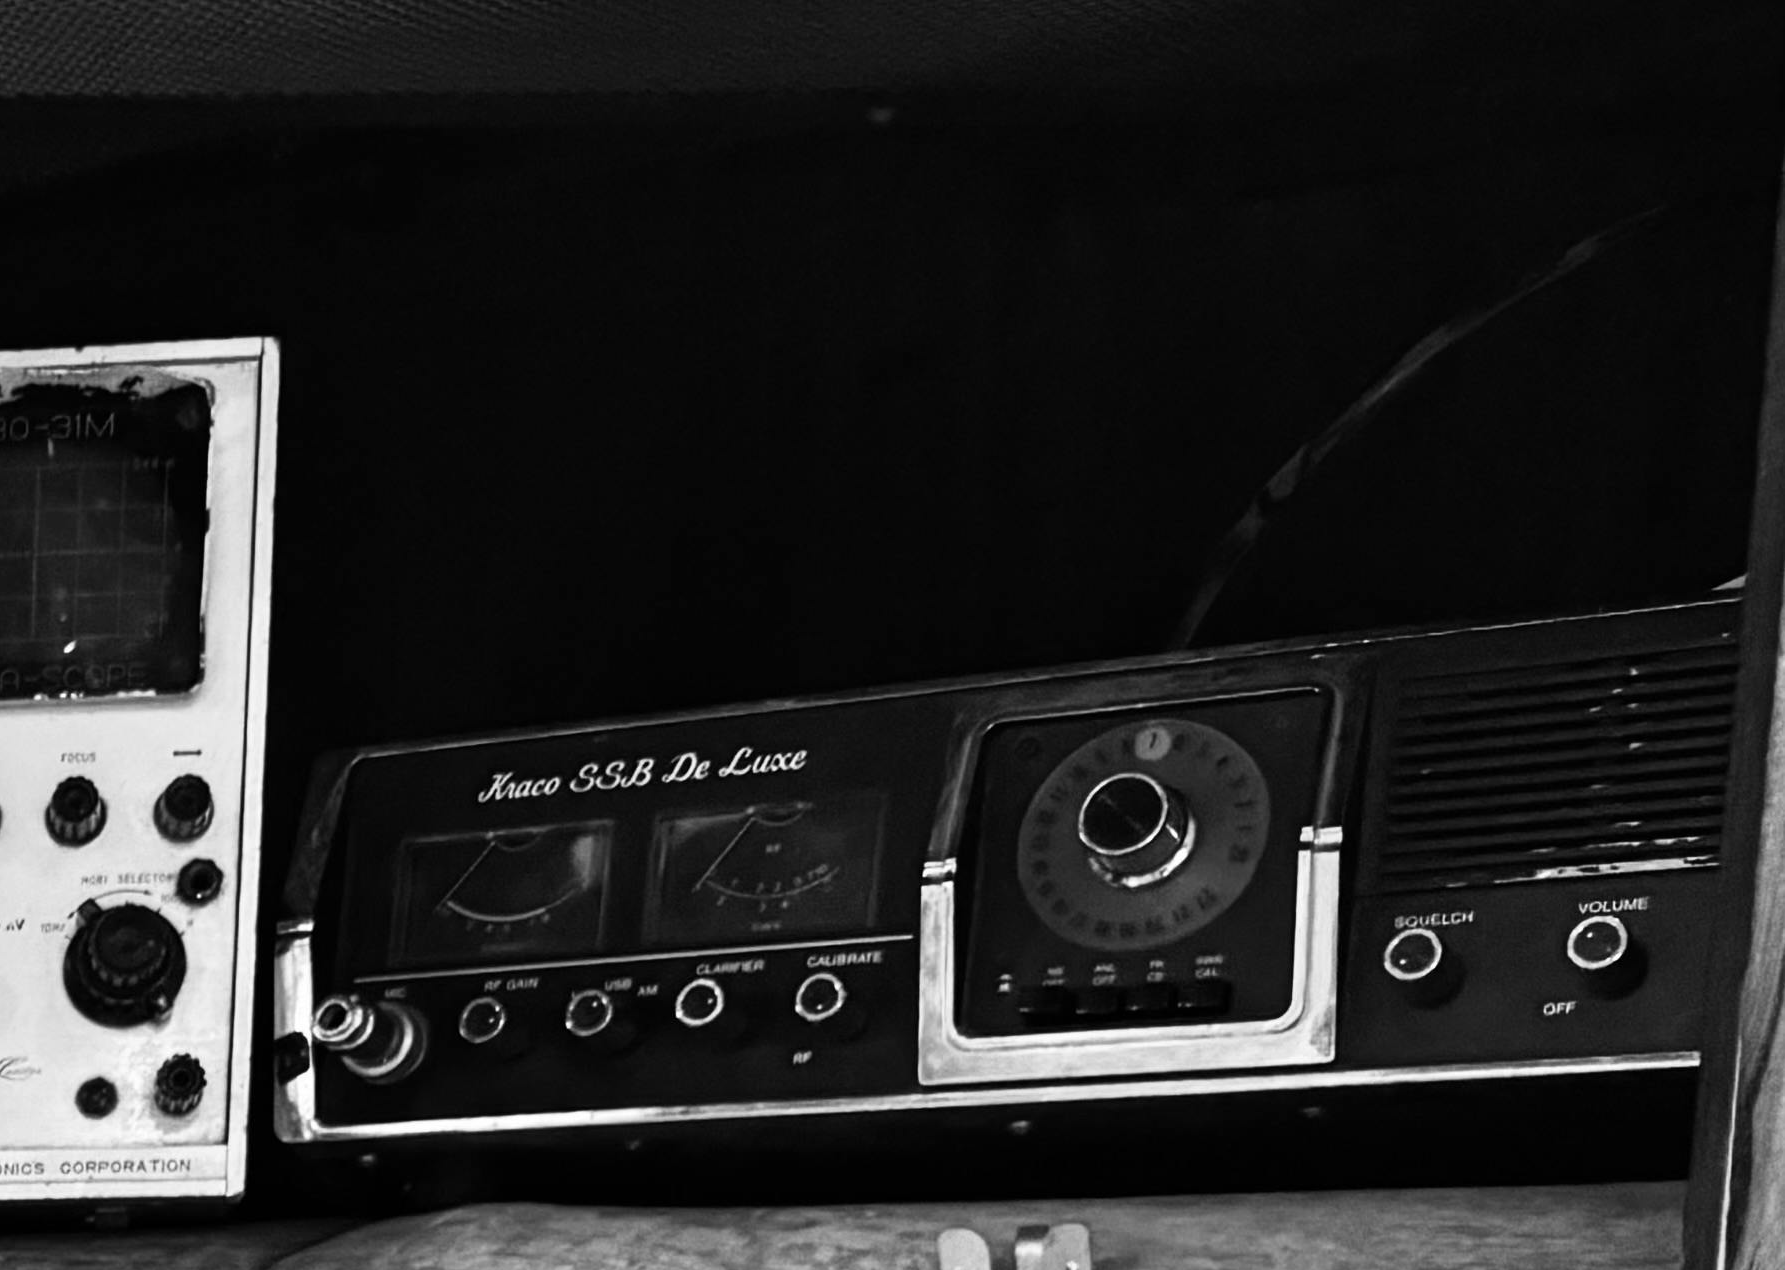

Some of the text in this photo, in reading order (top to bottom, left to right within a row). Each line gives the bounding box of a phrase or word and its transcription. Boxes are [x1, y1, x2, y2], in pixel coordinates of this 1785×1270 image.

[478, 748, 807, 802] Kraco SSB De Luxe
[1579, 898, 1647, 913] VOLUME
[1393, 911, 1475, 930] SQUELCH
[807, 951, 881, 967] CALIBRATE
[697, 960, 764, 974] CLARIFIER
[60, 1159, 190, 1174] CORPORATION
